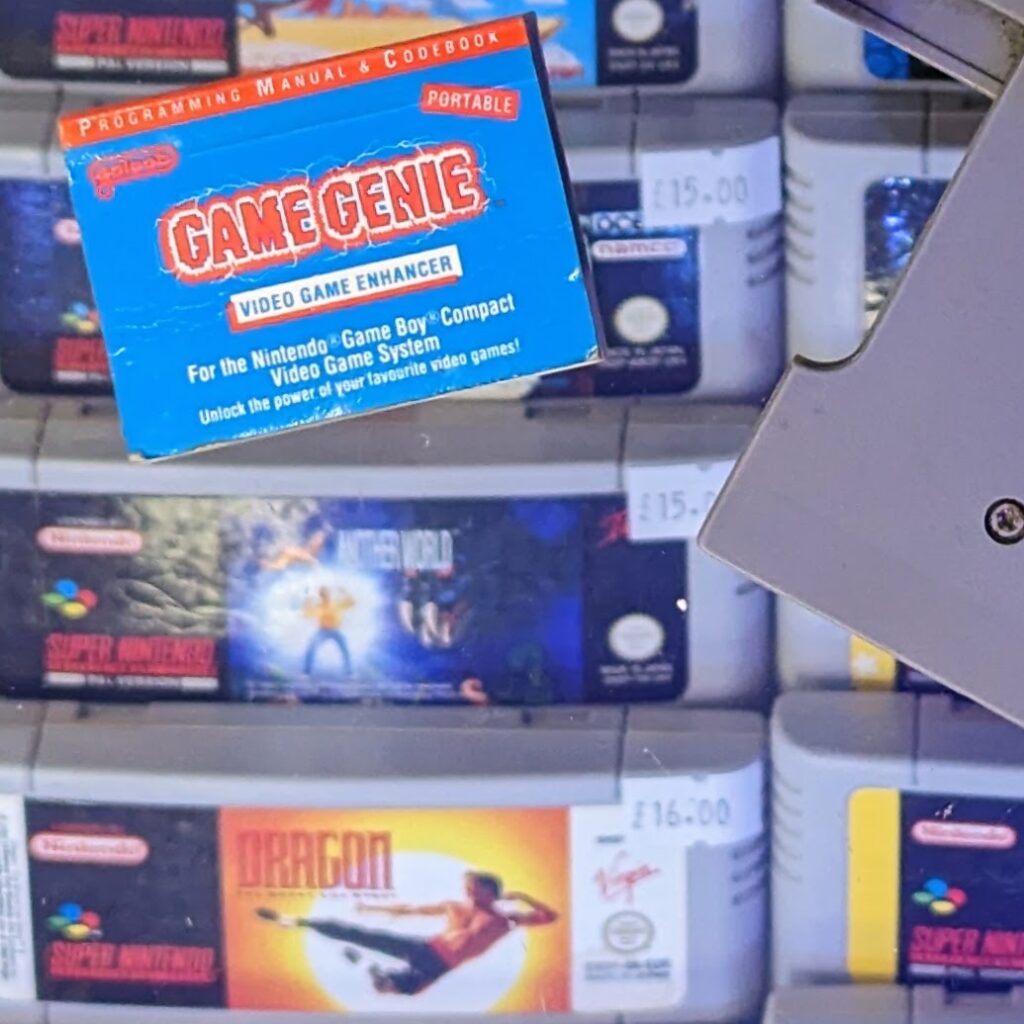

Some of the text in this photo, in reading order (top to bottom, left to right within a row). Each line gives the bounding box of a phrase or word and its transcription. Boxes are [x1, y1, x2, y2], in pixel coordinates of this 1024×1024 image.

[78, 31, 499, 137] PROGRAMMING MANUAL & CODEBOOK
[427, 89, 512, 114] PORTABLE
[168, 150, 481, 273] GAME GENIE
[652, 176, 750, 209] £15.00
[598, 240, 680, 256] namco
[239, 255, 454, 318] VIDEO GAME ENHANCER
[186, 364, 216, 384] For
[219, 356, 248, 377] the
[341, 324, 392, 350] Game
[440, 292, 516, 326] Compact
[269, 335, 441, 388] Video Game System
[199, 337, 520, 426] Unlock the power of your favourite video games!
[632, 797, 731, 829] £16.00
[236, 830, 393, 890] DRAGON
[912, 926, 980, 956] SUPER
